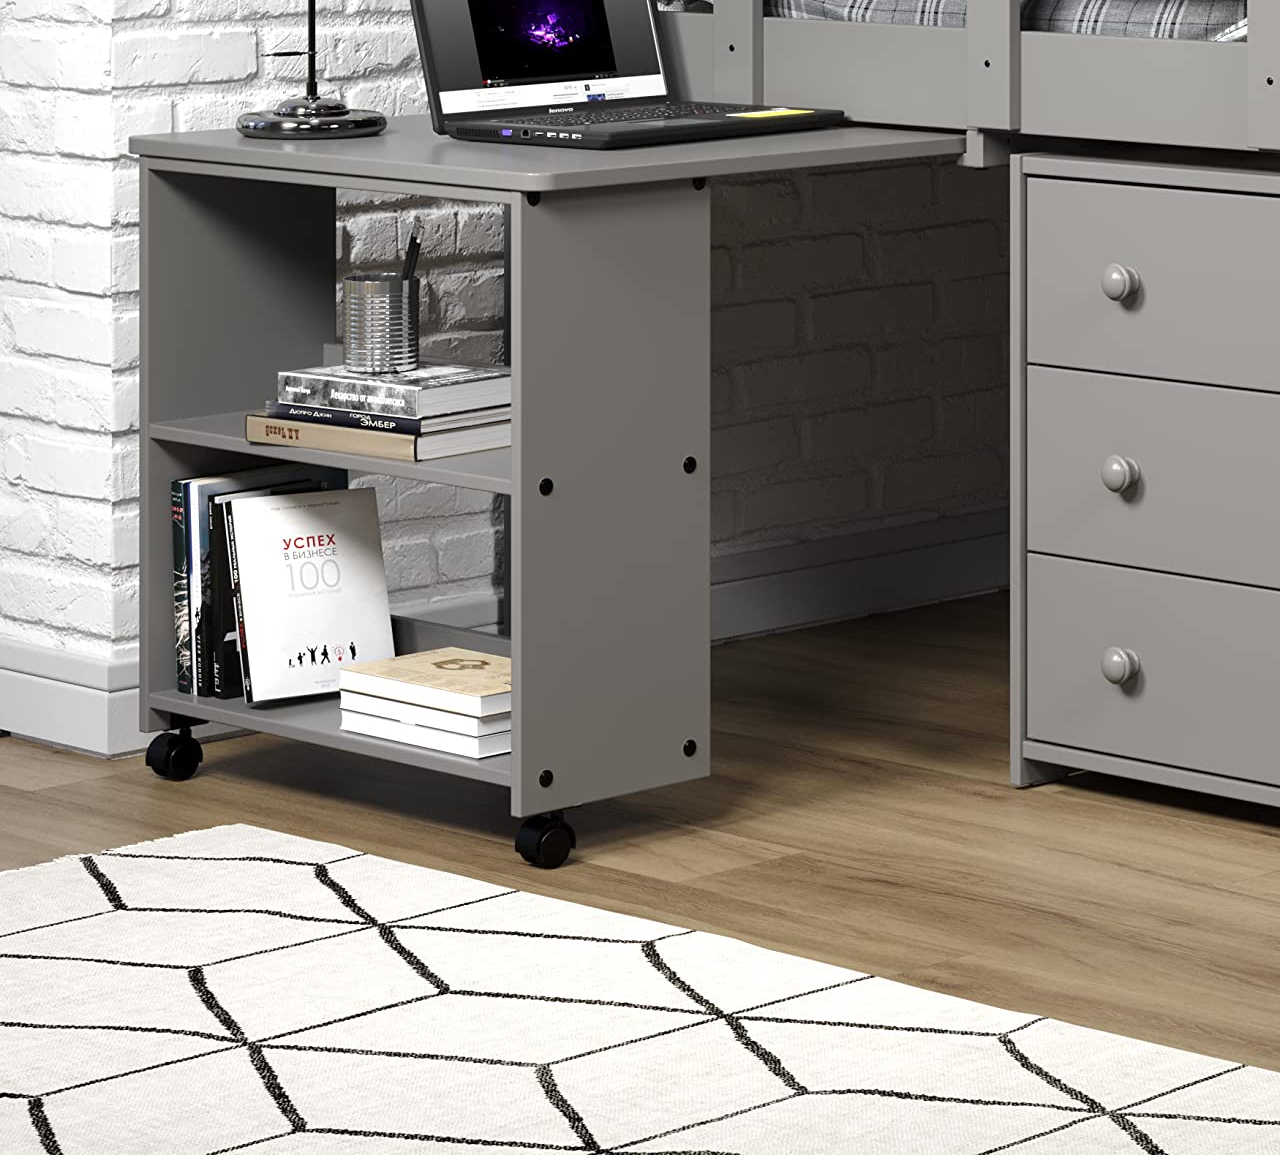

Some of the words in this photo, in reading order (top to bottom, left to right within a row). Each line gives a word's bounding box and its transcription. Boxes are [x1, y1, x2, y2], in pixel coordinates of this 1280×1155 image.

[360, 418, 396, 429] ЭМБЕР
[283, 534, 336, 551] УСПЕХ
[284, 552, 290, 561] В
[292, 548, 338, 560] БИЗНЕСЕ
[285, 559, 341, 592] 100
